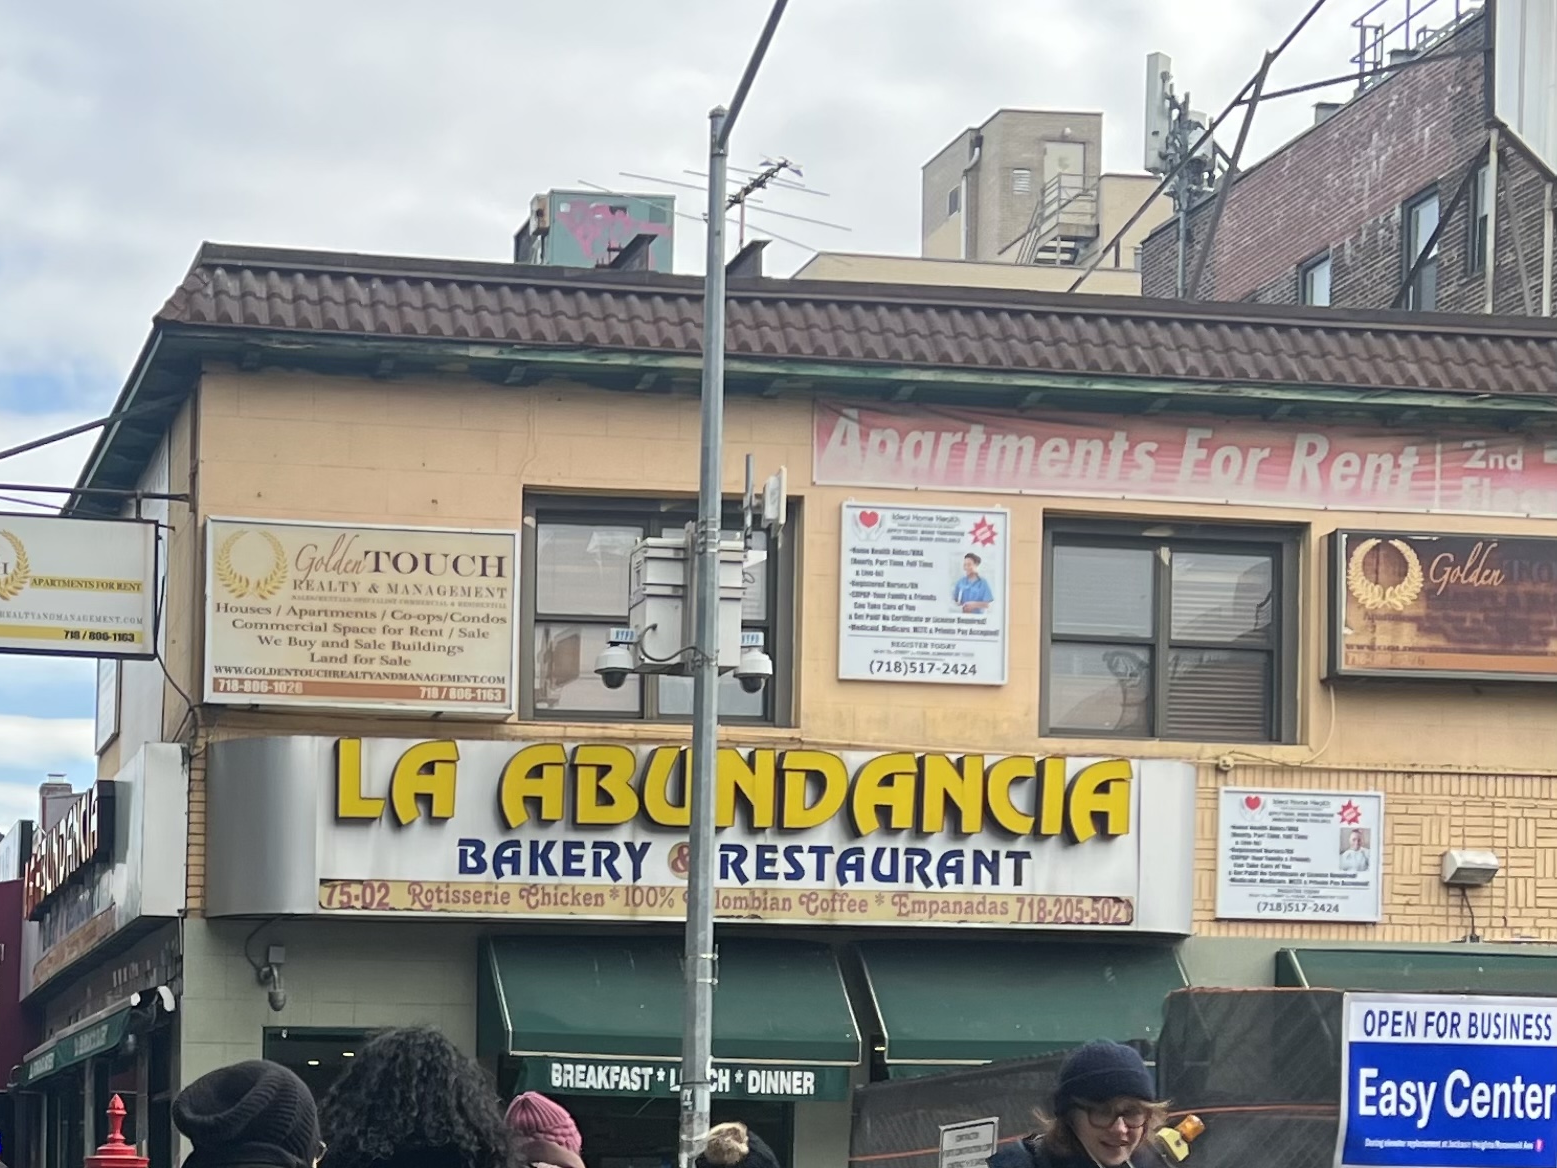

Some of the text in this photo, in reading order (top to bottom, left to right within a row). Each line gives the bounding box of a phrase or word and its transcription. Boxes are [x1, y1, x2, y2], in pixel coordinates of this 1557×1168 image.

[822, 408, 1419, 497] Apartments For Rent
[1462, 440, 1523, 471] 2nd
[295, 533, 507, 583] Golden TOUCH
[1429, 542, 1505, 596] Golden
[31, 578, 142, 592] APARTMENTS FOR RENT
[293, 579, 507, 599] REALTY & MANAGEMENT
[215, 602, 272, 615] Houses
[287, 605, 377, 619] Apartments
[232, 618, 327, 632] Commercial
[333, 622, 377, 636] Space
[382, 624, 404, 636] for
[409, 625, 444, 637] Rent
[458, 627, 490, 639] Sale
[257, 635, 464, 657] We Buy and Sale Buildings
[310, 652, 412, 667] Land for Sale
[869, 660, 977, 676] (718)517-2424
[419, 686, 439, 699] 718
[334, 737, 1134, 845] LA ABUNDANCIA
[456, 838, 652, 883] BAKERY
[718, 843, 1032, 889] RESTAURANT
[408, 885, 511, 911] Rotisserie
[519, 884, 606, 910] Chicken
[624, 886, 674, 908] 100%
[683, 889, 792, 912] lombian
[798, 890, 868, 916] Coffee
[891, 892, 1009, 920] Empanadas
[1256, 902, 1340, 914] (718)517-2424
[1363, 1009, 1552, 1041] OPEN FOR BUSINESS
[550, 1063, 816, 1095] BREAKFAST LCH DINNER
[1358, 1067, 1556, 1129] Easy Center
